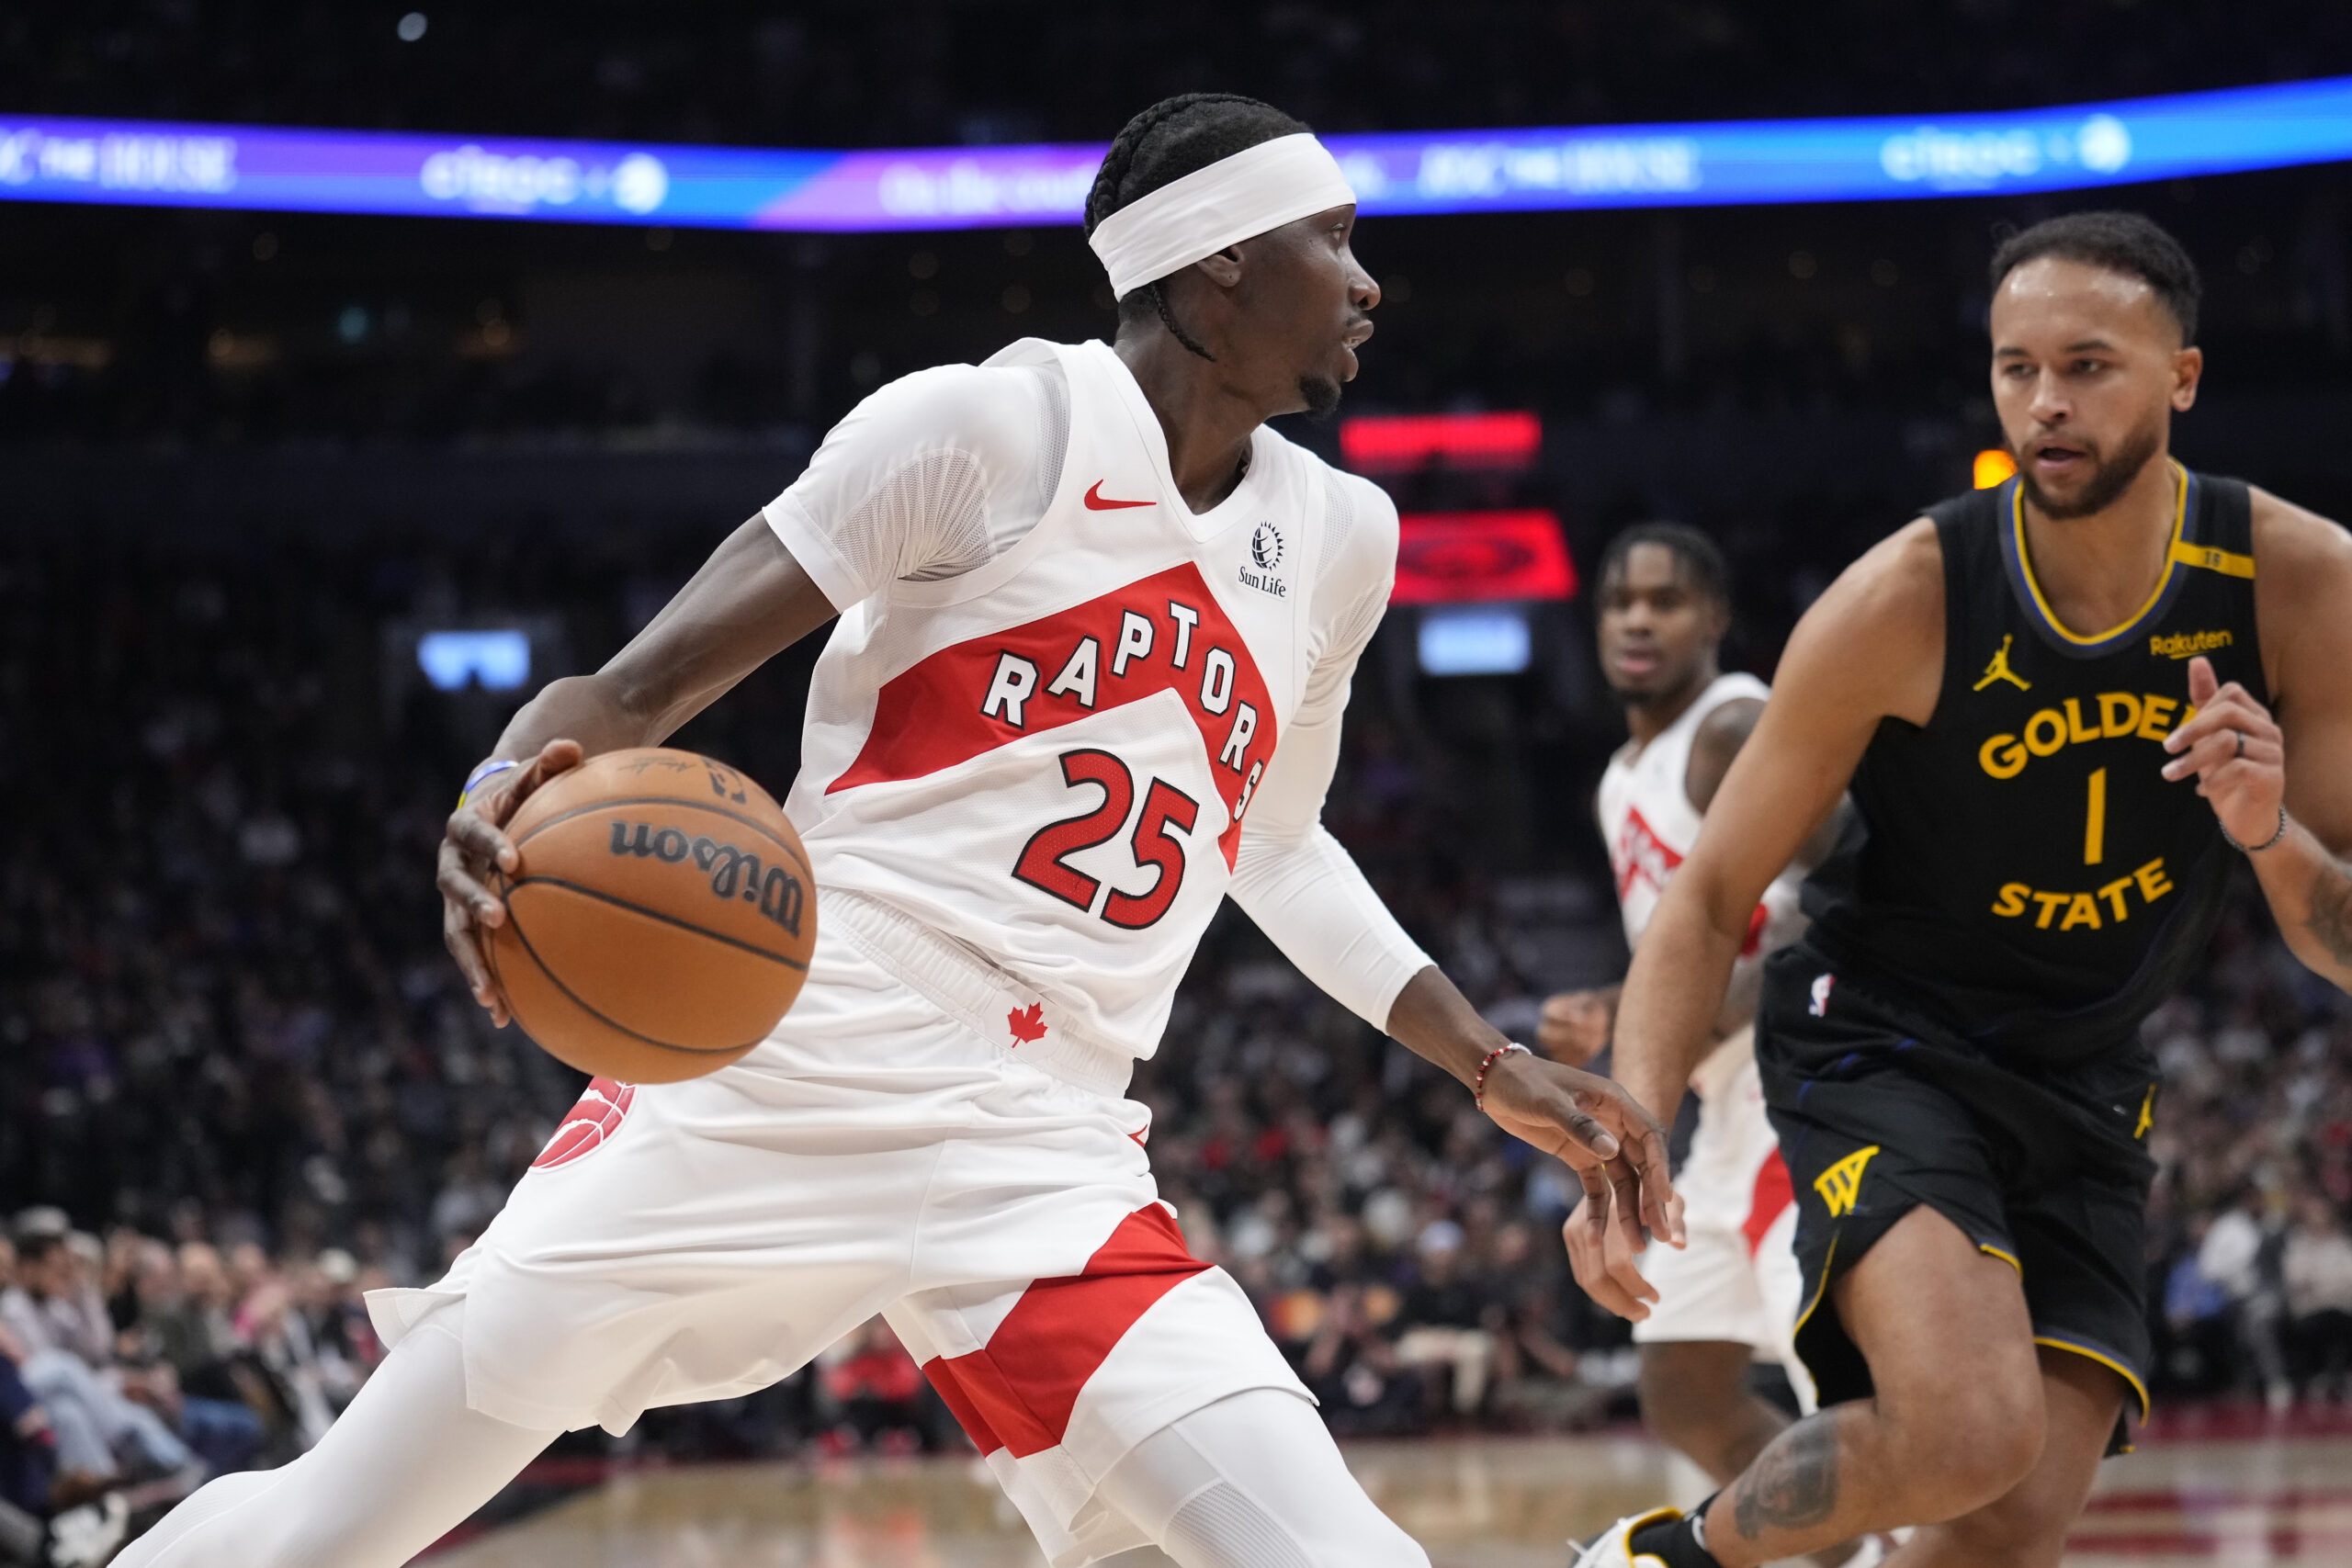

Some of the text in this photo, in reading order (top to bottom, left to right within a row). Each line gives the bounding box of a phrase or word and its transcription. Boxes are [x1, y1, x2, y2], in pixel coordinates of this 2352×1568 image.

[1238, 566, 1286, 597] Sun Life
[2150, 630, 2233, 656] Rakuten
[980, 599, 1263, 822] RAPTORS
[1012, 749, 1200, 930] 25
[2084, 766, 2107, 865] 1
[609, 819, 804, 940] Wilson
[1991, 857, 2174, 931] STATE
